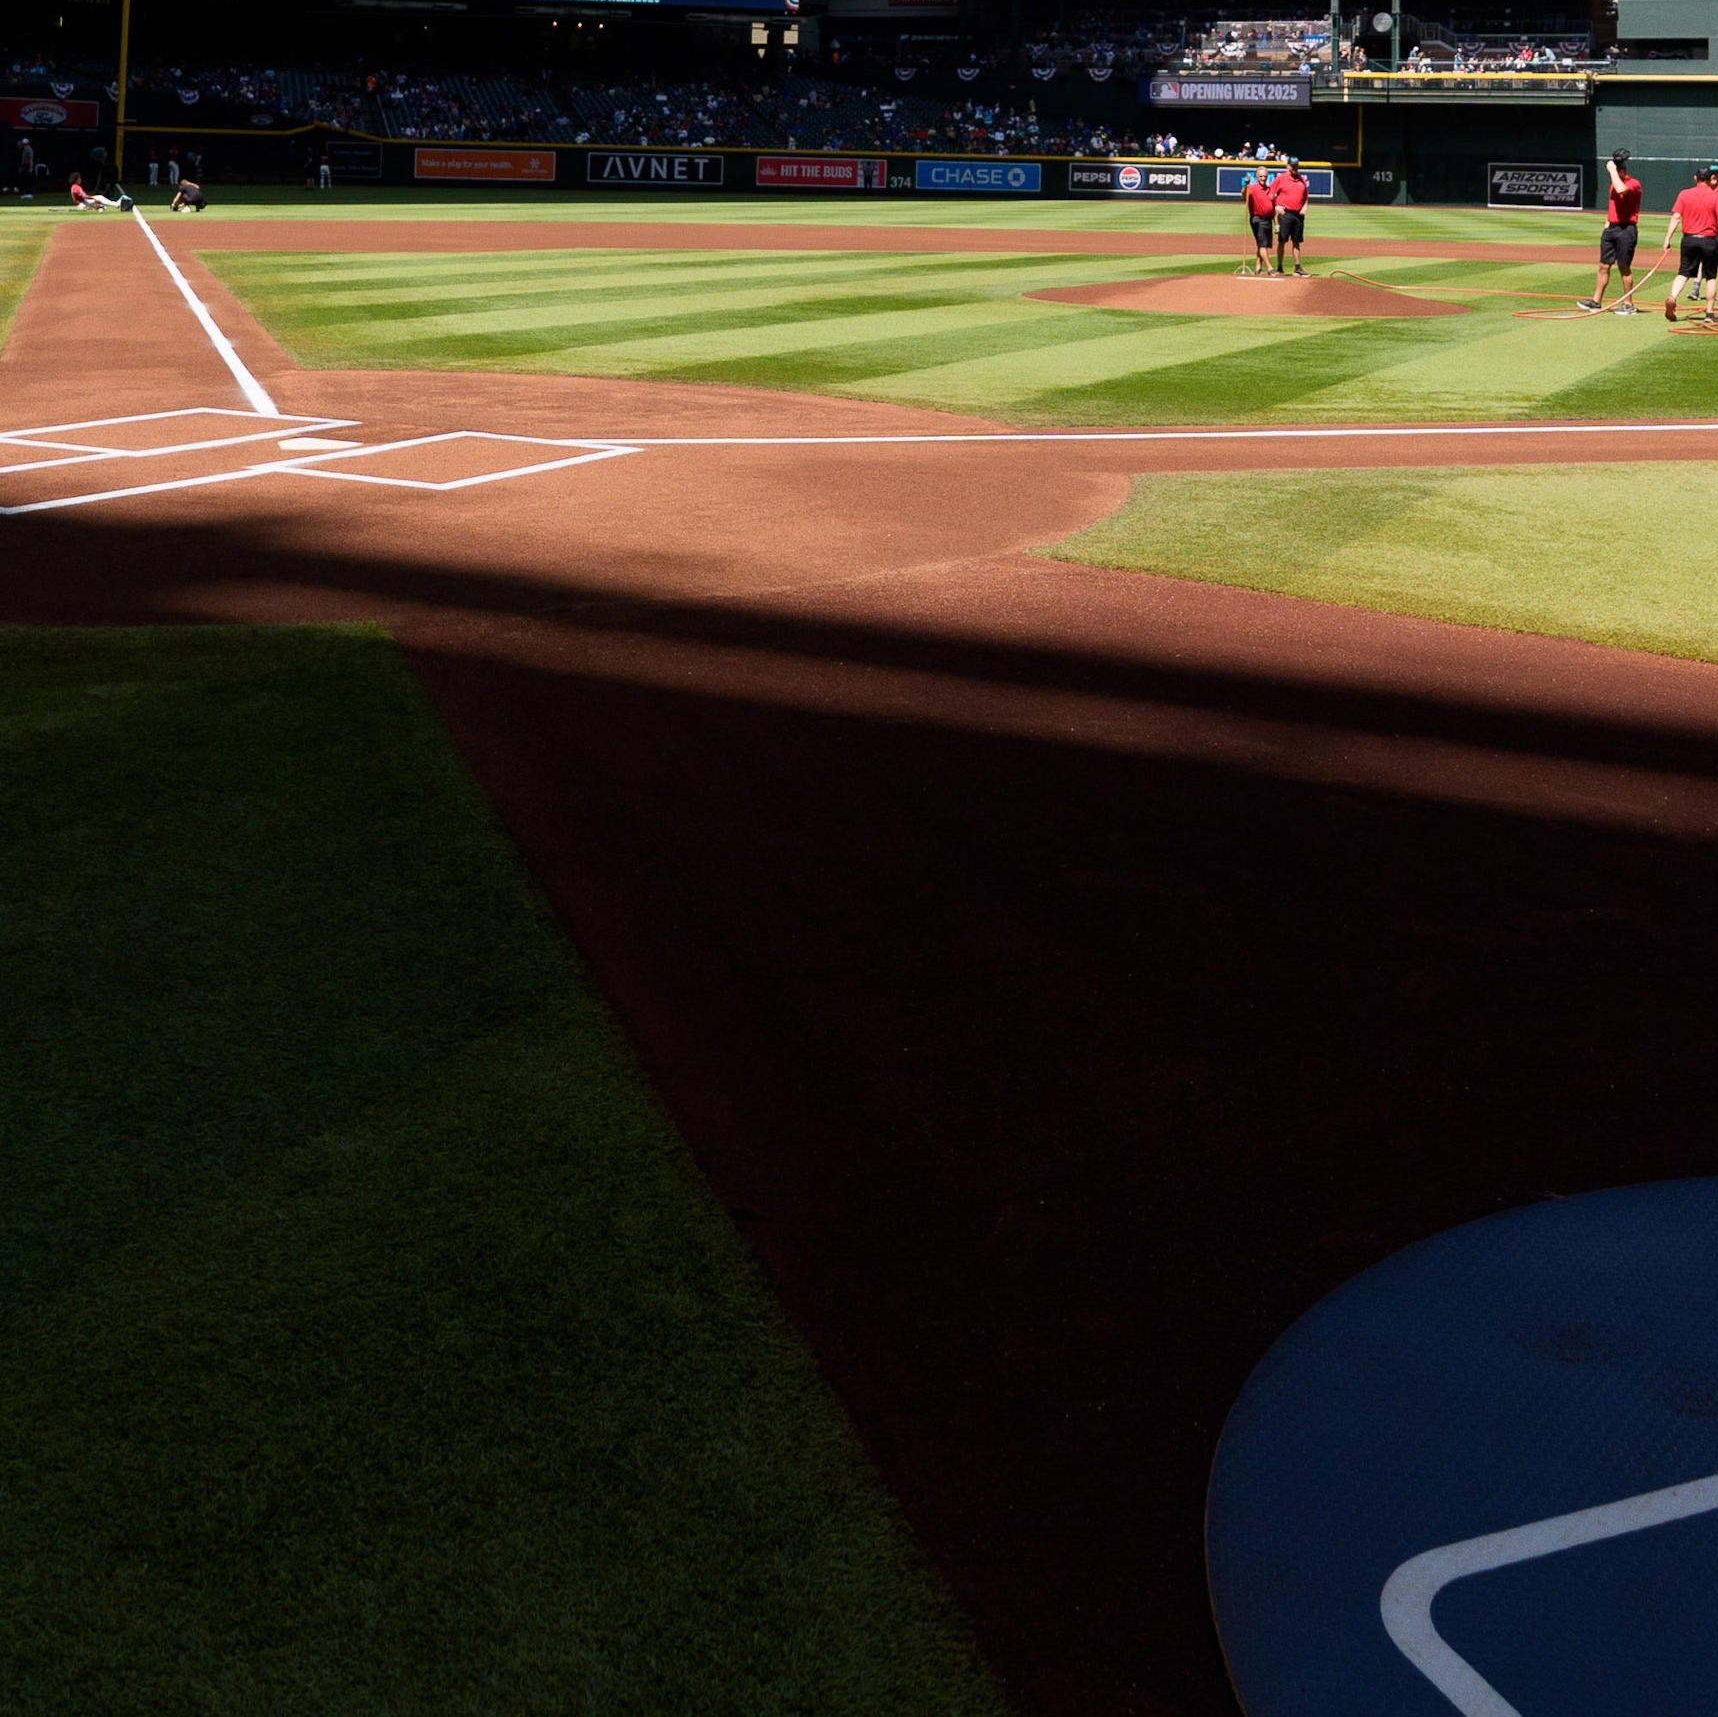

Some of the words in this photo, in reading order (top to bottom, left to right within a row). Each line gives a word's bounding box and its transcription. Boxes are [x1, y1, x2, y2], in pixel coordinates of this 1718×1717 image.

[1181, 84, 1232, 100] OPENING
[1234, 84, 1266, 100] WEEK
[1267, 84, 1297, 100] 2025
[603, 156, 708, 180] AVNET
[780, 165, 798, 176] HIT
[801, 165, 821, 177] THE
[823, 166, 852, 178] BUDS
[890, 176, 911, 188] 374
[932, 168, 1003, 185] CHASE
[1074, 172, 1111, 182] PEPSI
[1149, 174, 1186, 184] PEPSI
[1373, 171, 1392, 182] 413
[1498, 173, 1568, 182] ARIZONA
[1506, 184, 1570, 193] SPORTS
